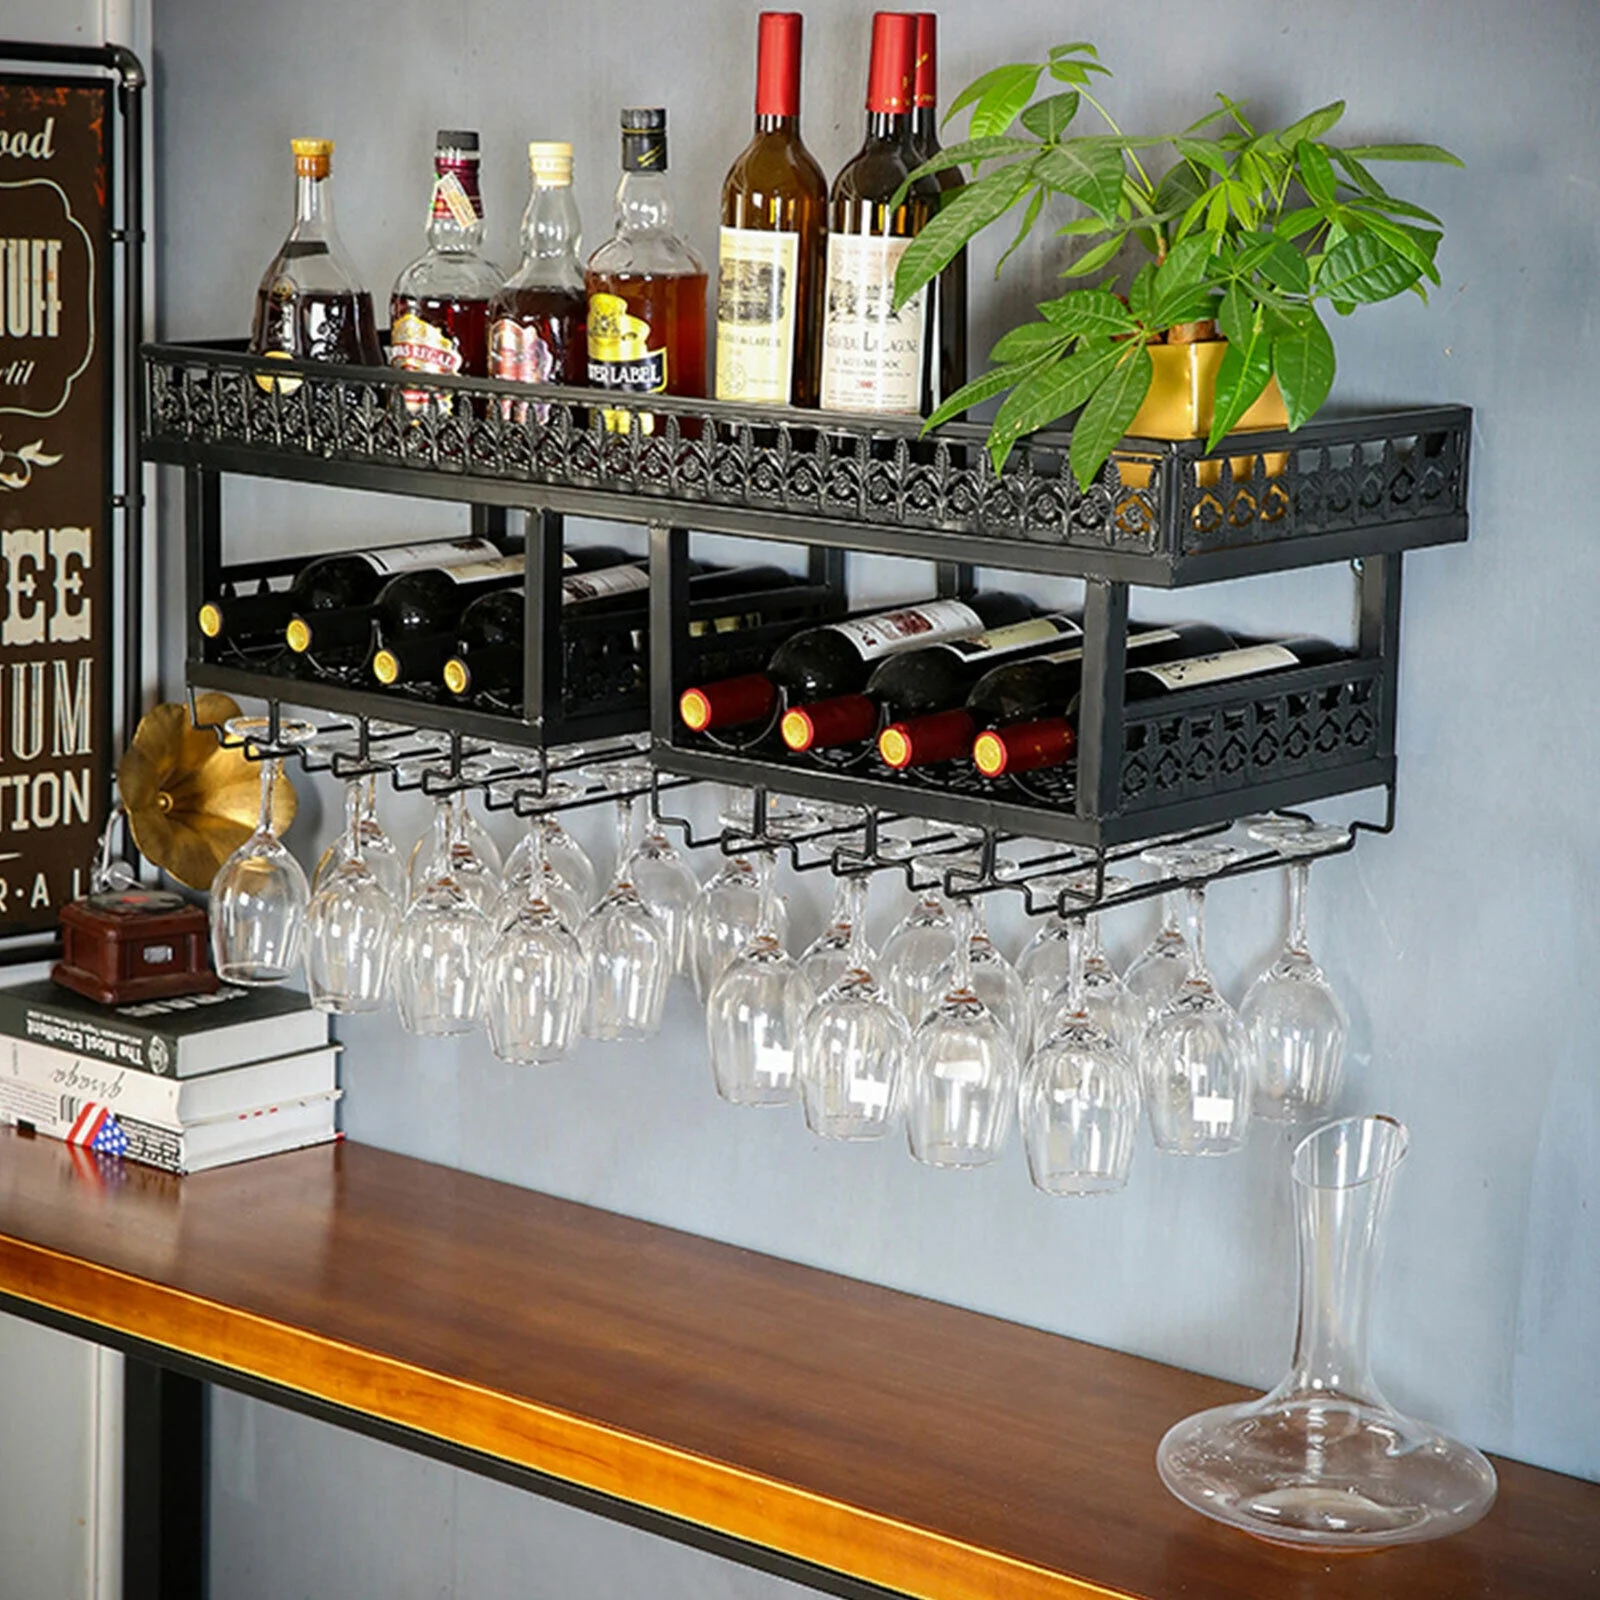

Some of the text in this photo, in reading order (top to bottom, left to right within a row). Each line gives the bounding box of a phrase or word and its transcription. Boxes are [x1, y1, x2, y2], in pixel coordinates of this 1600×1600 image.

[610, 363, 662, 384] LABEL
[0, 657, 94, 763] UM
[26, 1018, 83, 1050] Excellent
[84, 1033, 117, 1059] Most
[118, 1042, 144, 1066] The
